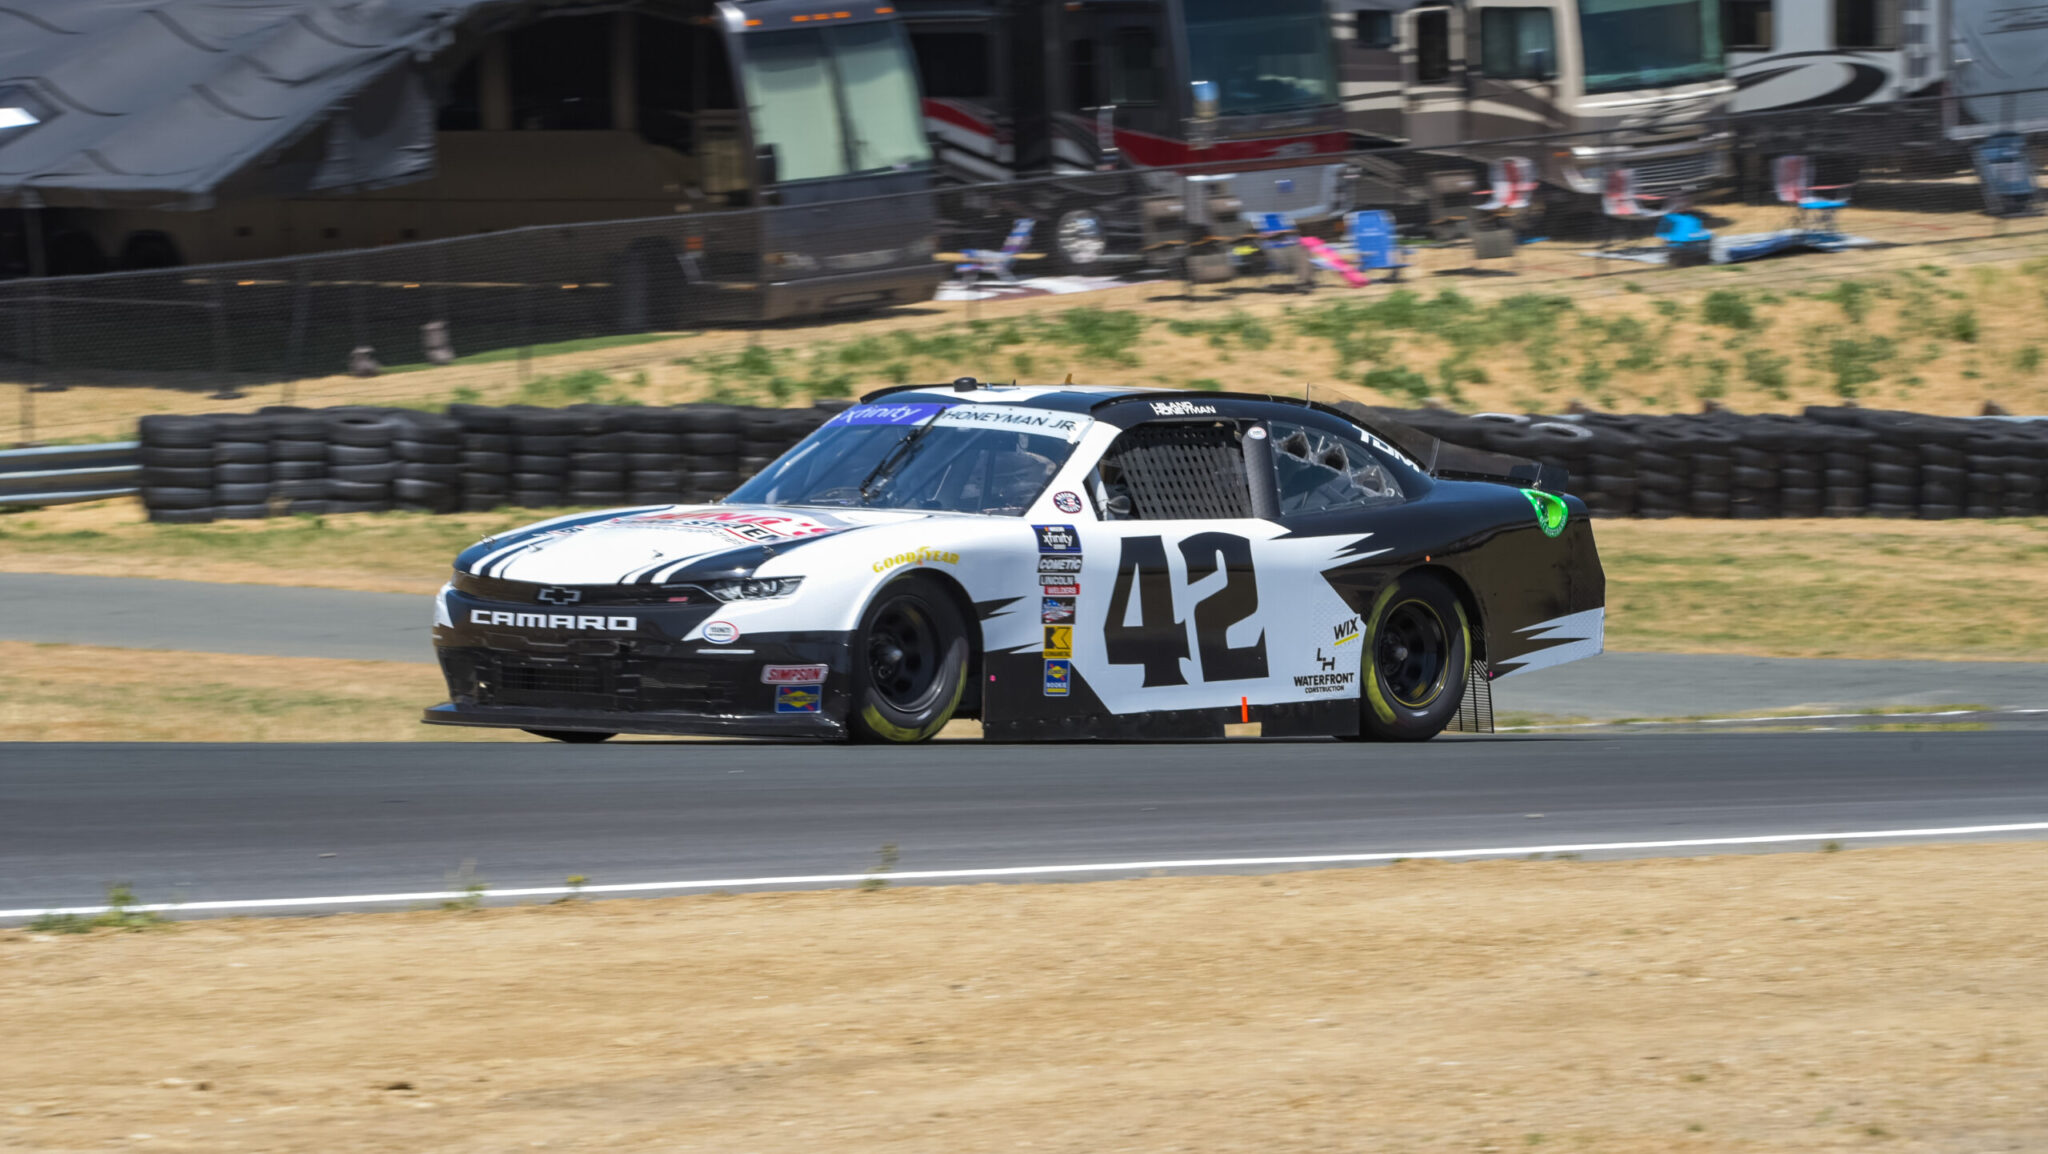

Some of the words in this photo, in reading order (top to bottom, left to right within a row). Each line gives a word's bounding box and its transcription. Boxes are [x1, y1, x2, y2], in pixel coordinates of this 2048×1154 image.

[942, 411, 1049, 426] HONEYMAN
[872, 546, 961, 573] GOODYEAR
[1039, 558, 1082, 570] COMETIC
[1040, 576, 1075, 585] LINCOLN
[1103, 531, 1270, 688] 42
[470, 609, 638, 631] CAMARO
[1334, 616, 1359, 640] WIX
[766, 668, 821, 681] SIMPSON
[1293, 672, 1355, 687] WATERFRONT
[1304, 685, 1345, 694] CONSTRUCTION
